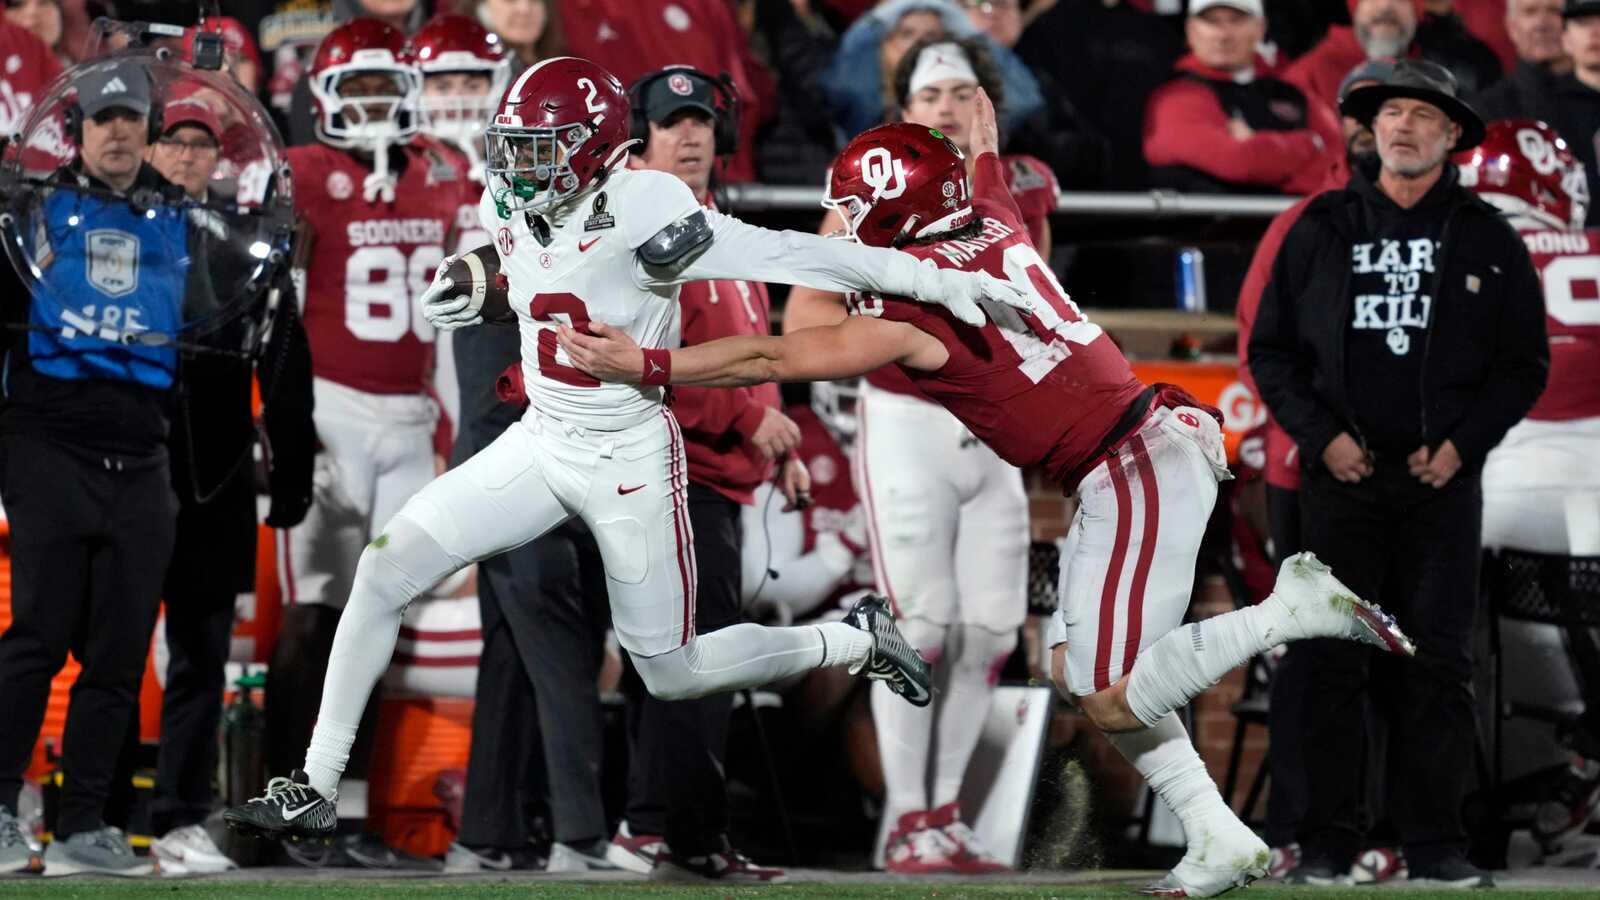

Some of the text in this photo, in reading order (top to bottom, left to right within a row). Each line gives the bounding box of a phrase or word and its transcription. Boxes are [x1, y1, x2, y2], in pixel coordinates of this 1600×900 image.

[577, 77, 608, 113] 2
[861, 147, 907, 200] OU
[1352, 238, 1442, 274] HAR
[1384, 271, 1420, 295] TO
[978, 243, 1103, 385] 10
[529, 292, 601, 388] 2
